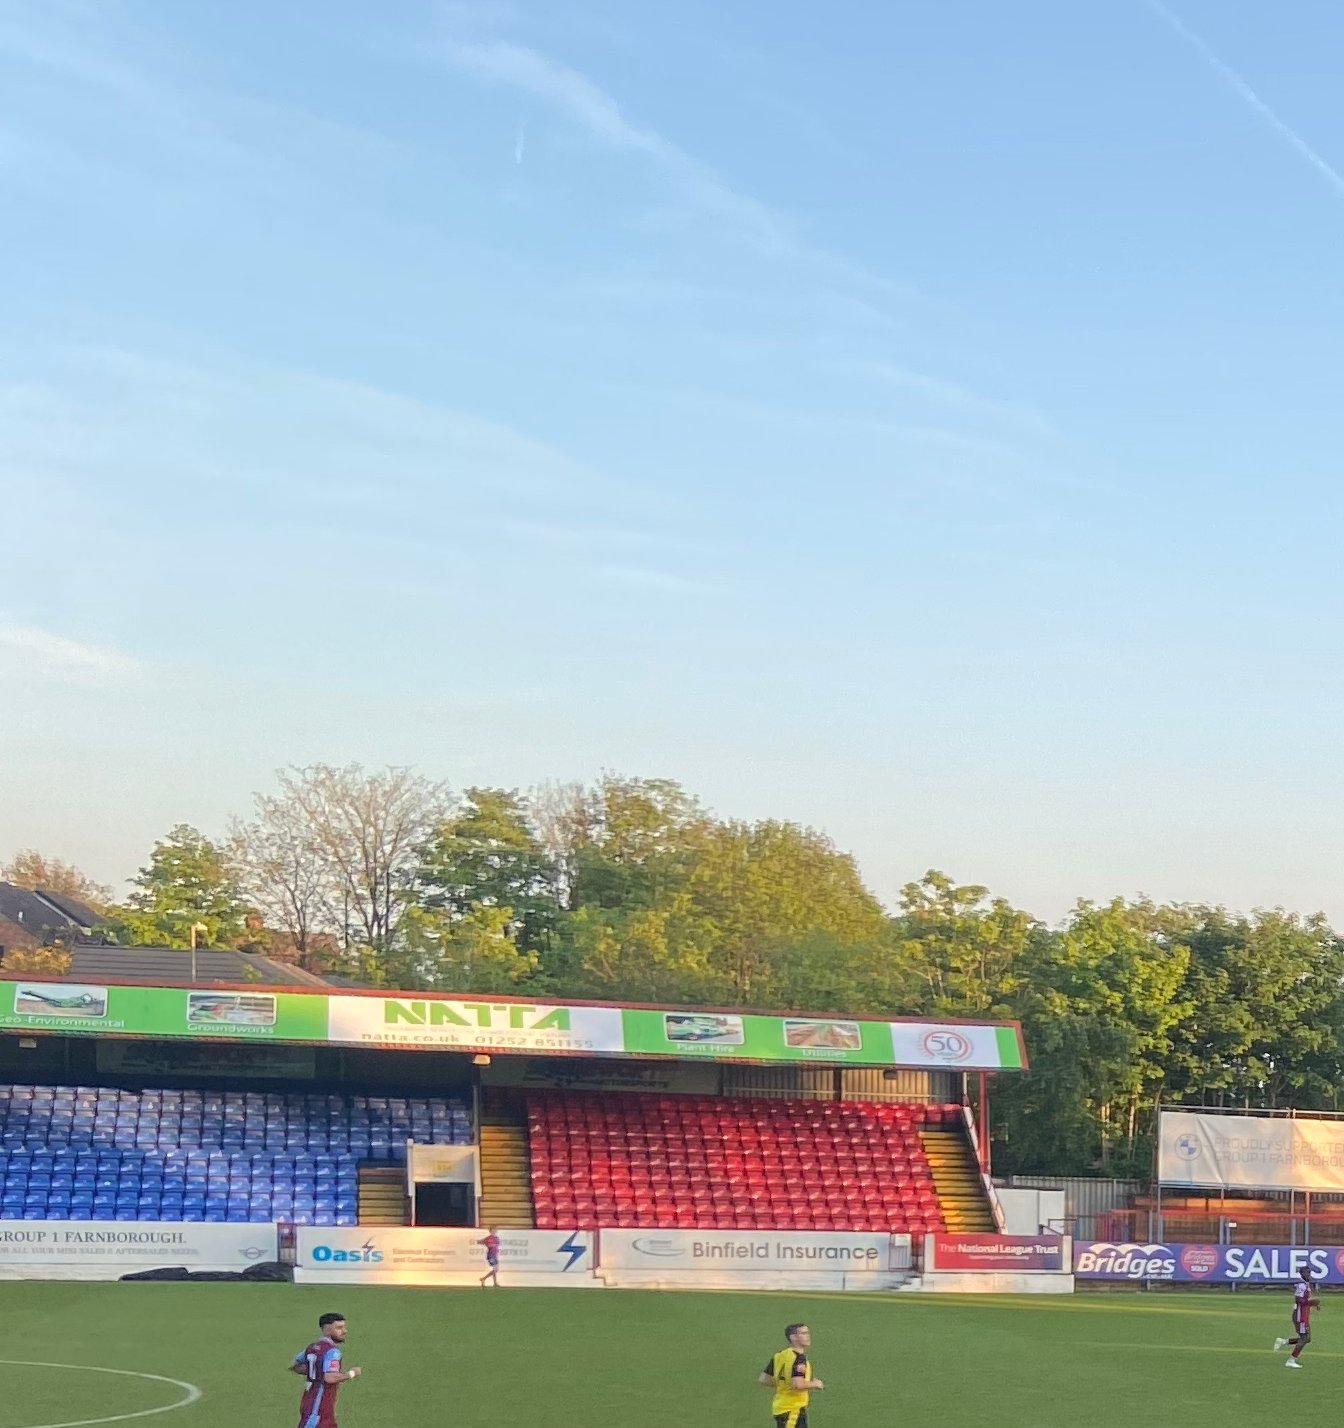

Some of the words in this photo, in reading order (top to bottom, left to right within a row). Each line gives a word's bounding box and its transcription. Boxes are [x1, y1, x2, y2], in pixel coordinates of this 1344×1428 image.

[384, 1000, 571, 1031] NATTA
[187, 1023, 274, 1034] Groundworks
[362, 1033, 459, 1043] natta.co.uk
[475, 1036, 527, 1046] 01252
[929, 1033, 962, 1051] 50
[0, 1231, 46, 1243] ROUP
[52, 1232, 58, 1242] 1
[312, 1245, 384, 1263] Oasis
[693, 1242, 769, 1259] Binfield
[777, 1242, 878, 1260] Insurance
[940, 1243, 956, 1254] The
[958, 1243, 998, 1254] National
[1000, 1244, 1034, 1256] League
[1035, 1244, 1059, 1255] Trust
[1077, 1252, 1175, 1278] Bridges
[1225, 1248, 1328, 1279] SALES
